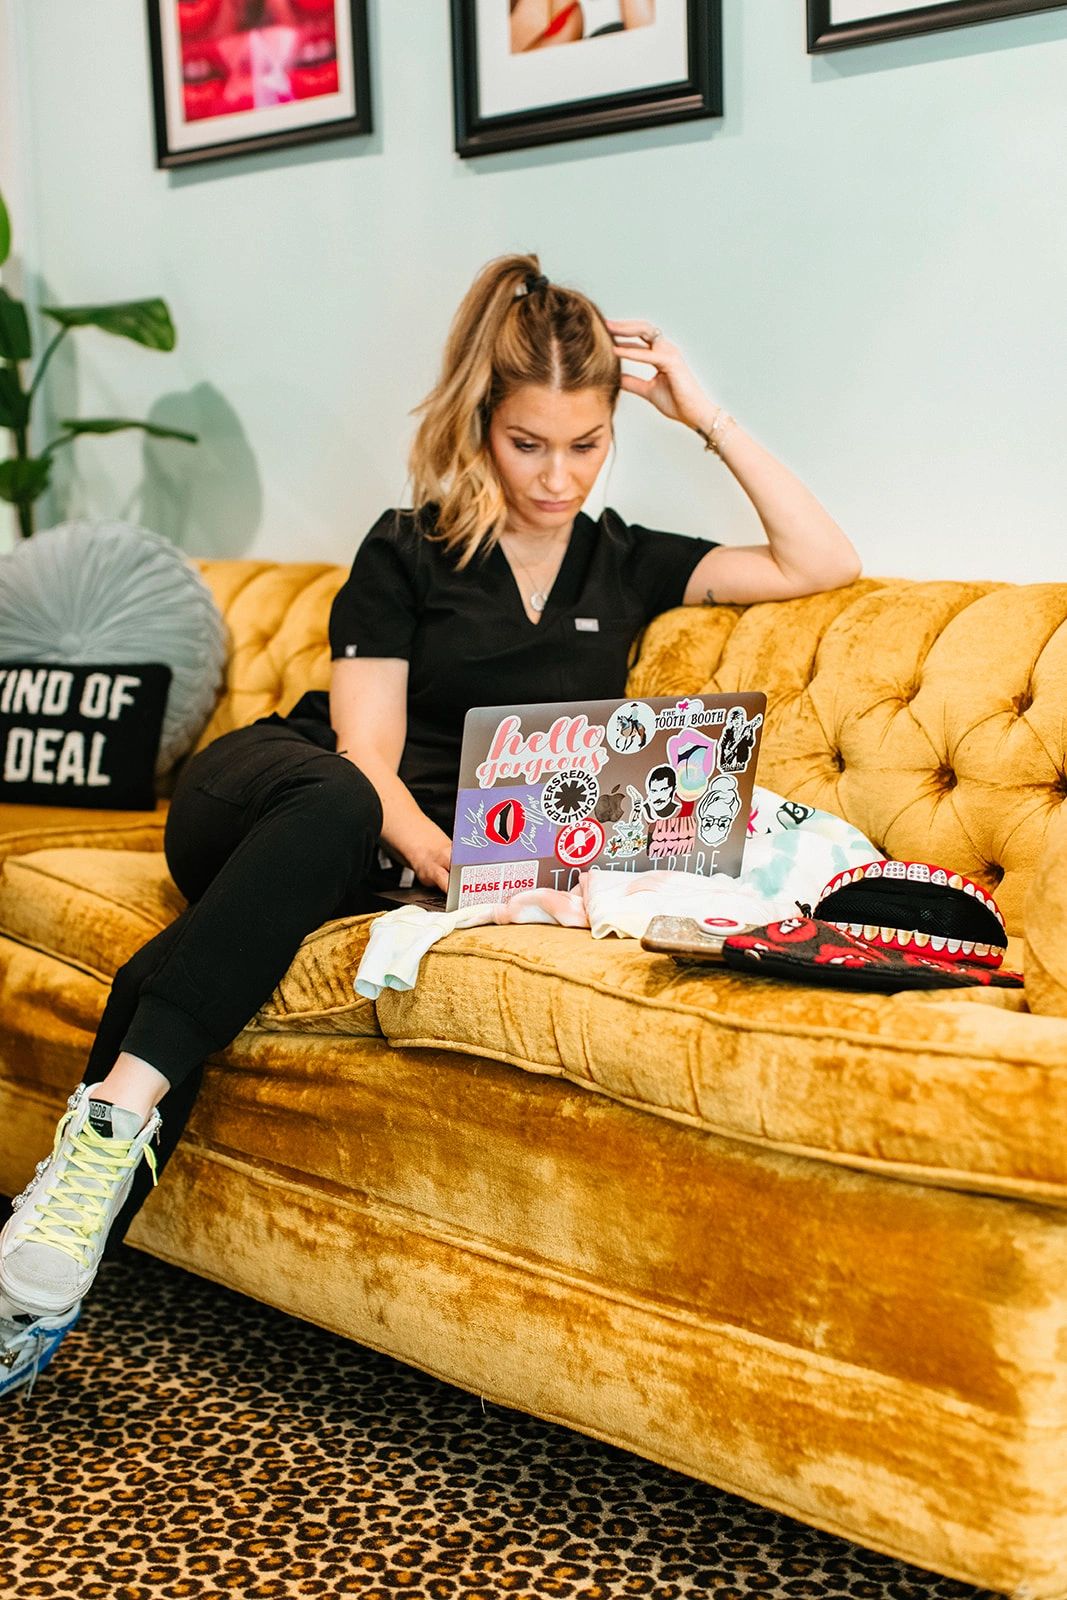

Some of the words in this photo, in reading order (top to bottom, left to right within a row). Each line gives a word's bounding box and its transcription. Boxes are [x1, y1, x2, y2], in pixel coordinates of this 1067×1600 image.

[79, 672, 142, 720] OF
[490, 718, 603, 761] hello
[655, 714, 686, 728] TOOTH
[690, 711, 724, 725] BOOTH
[3, 727, 111, 787] DEAL
[479, 749, 605, 786] gorgeous
[461, 881, 500, 894] PLEASE
[502, 878, 535, 890] FLOSS
